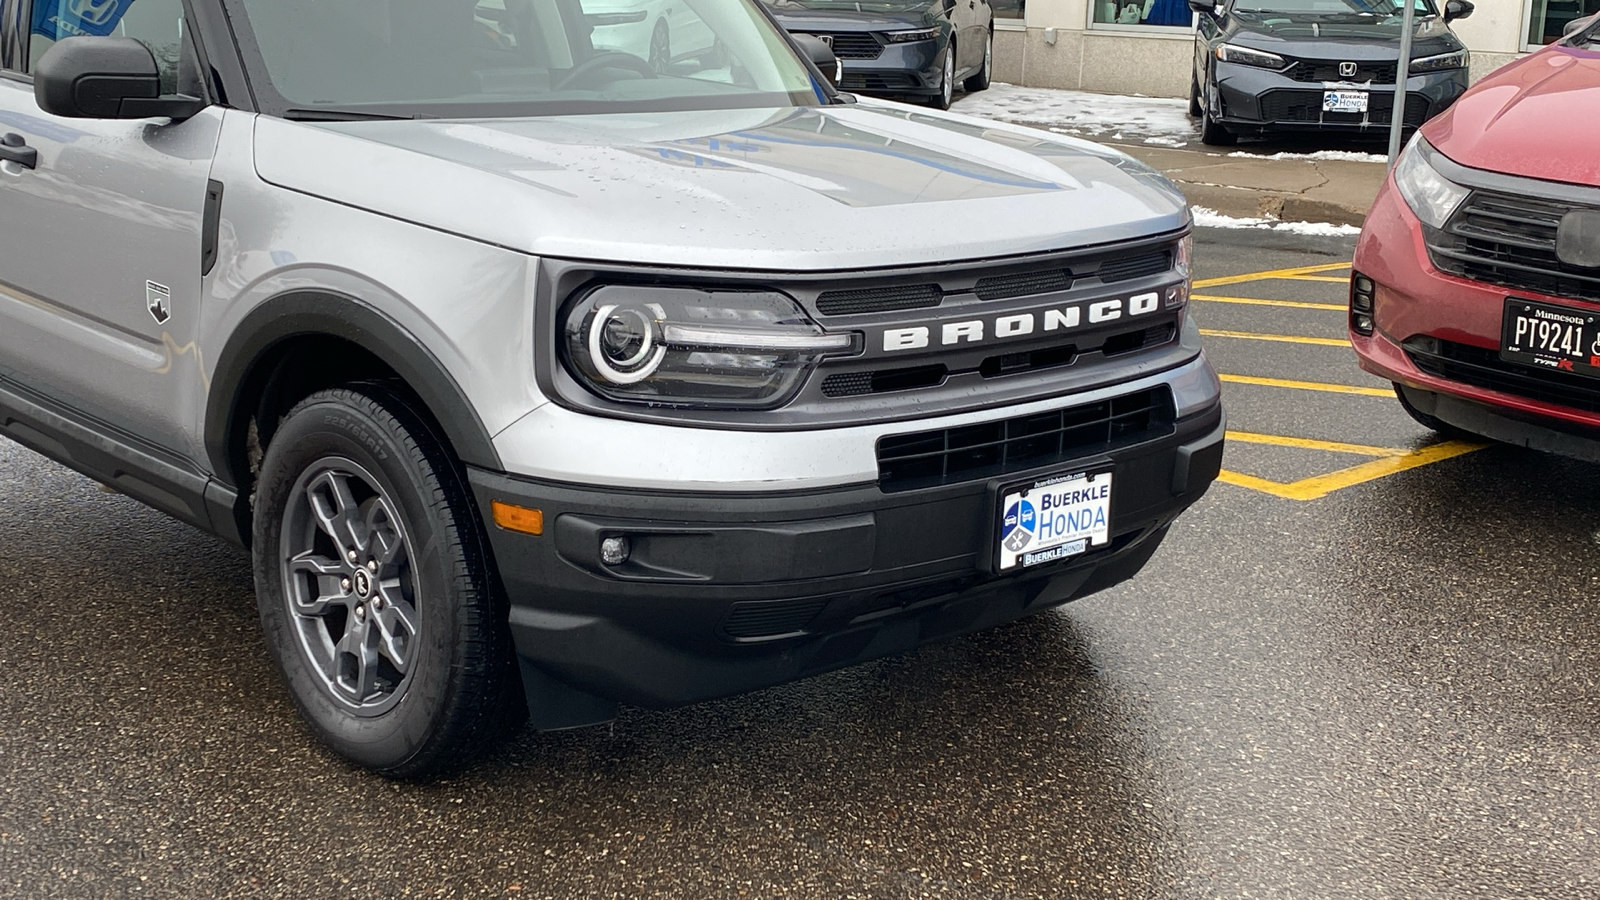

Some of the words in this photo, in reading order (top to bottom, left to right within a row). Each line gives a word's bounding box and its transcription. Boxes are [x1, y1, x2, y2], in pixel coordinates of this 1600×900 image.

[1339, 99, 1367, 107] HONDA
[883, 292, 1159, 352] BRONCO
[1534, 309, 1585, 326] Minnesota
[1514, 315, 1584, 357] PT9241
[1041, 485, 1109, 511] BUERKLE
[1038, 506, 1106, 540] HONDA
